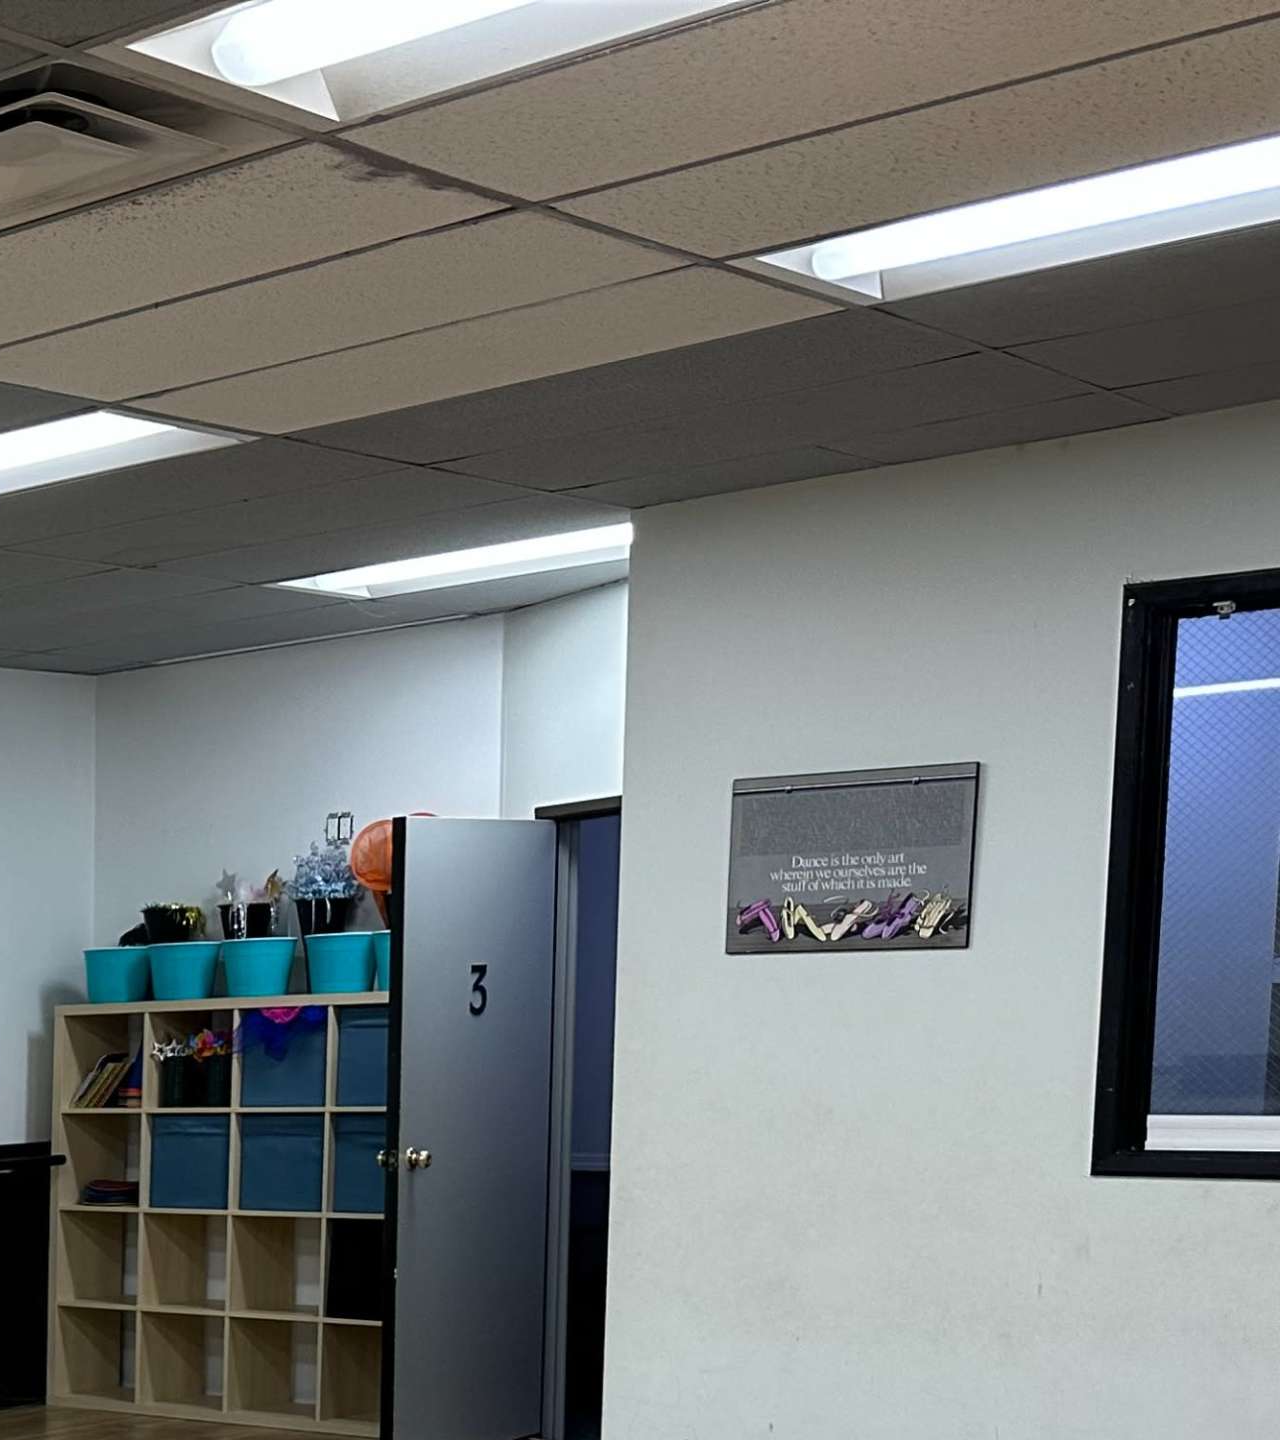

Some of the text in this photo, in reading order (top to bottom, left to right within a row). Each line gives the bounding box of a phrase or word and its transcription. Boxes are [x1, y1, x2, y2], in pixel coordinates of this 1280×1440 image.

[791, 851, 905, 868] Dance is the only art
[769, 862, 928, 880] wherein we ourselves are the
[781, 880, 806, 892] stuff
[807, 879, 819, 891] of
[820, 878, 856, 890] which
[857, 878, 865, 889] it
[866, 878, 876, 889] is
[469, 964, 487, 1016] 3
